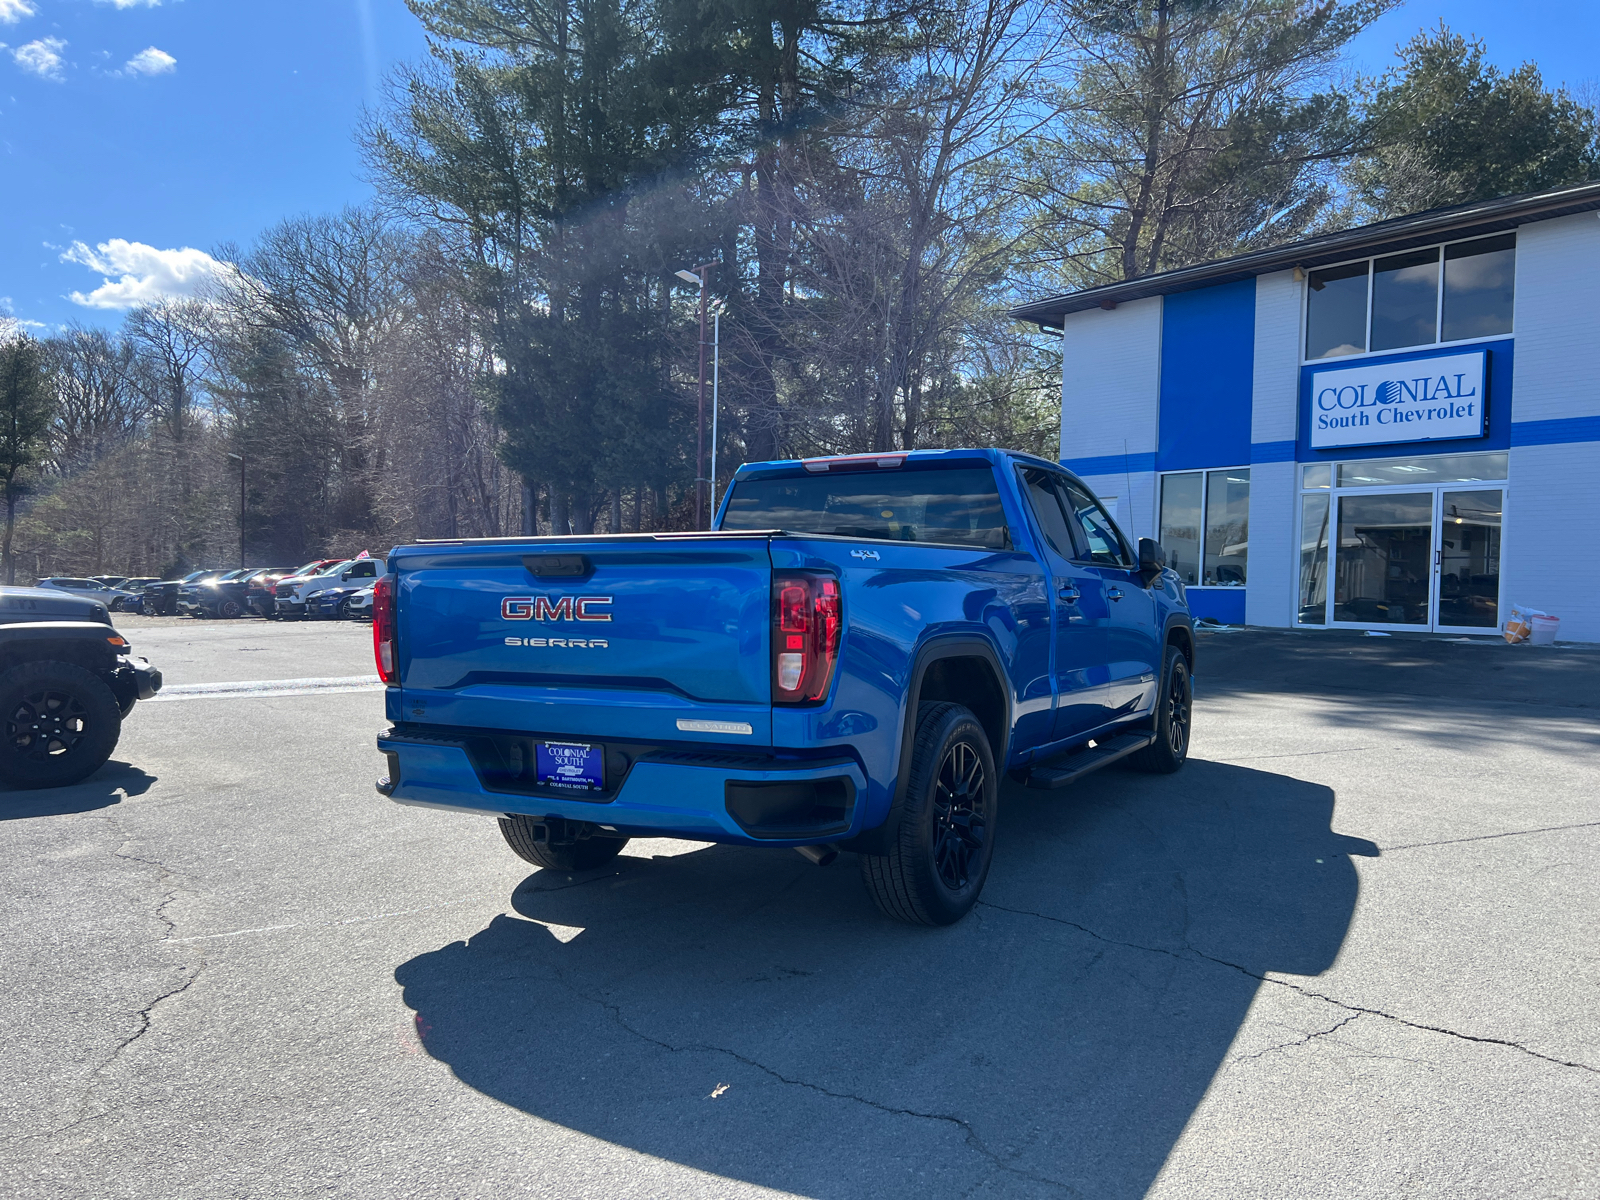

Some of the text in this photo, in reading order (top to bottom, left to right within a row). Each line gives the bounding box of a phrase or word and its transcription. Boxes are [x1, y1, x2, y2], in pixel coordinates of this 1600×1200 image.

[1318, 373, 1476, 411] COLONIAL
[1318, 401, 1475, 430] South Chevrolet
[501, 596, 613, 621] GMC
[504, 637, 609, 648] SIERRA
[548, 747, 590, 758] COLONIAL
[555, 757, 584, 766] SOUTH
